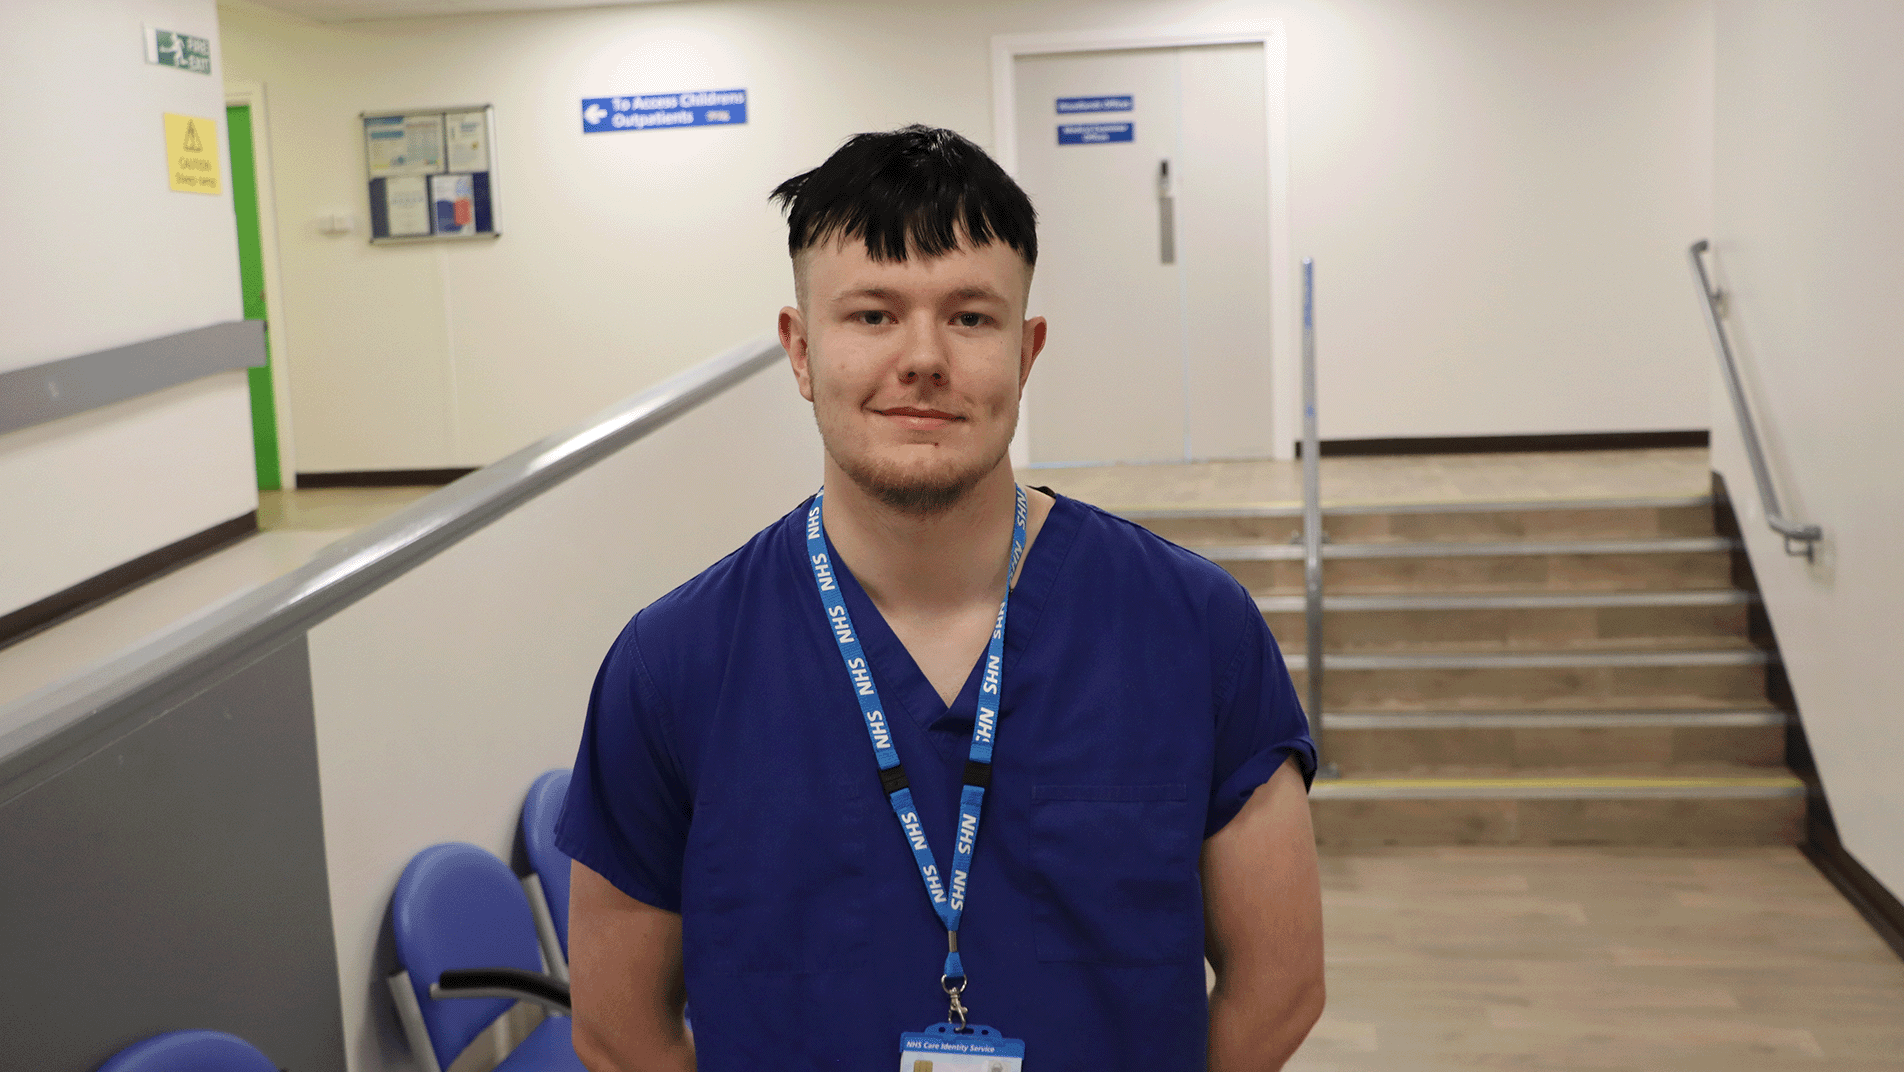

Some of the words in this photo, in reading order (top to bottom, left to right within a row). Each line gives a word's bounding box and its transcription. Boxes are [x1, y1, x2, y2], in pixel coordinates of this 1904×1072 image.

[189, 55, 210, 73] EXIT
[611, 110, 695, 129] Outpatients
[612, 97, 631, 112] To
[632, 95, 679, 111] Access
[808, 506, 820, 540] NHS
[1016, 490, 1028, 531] NHS
[812, 552, 836, 592] NHS
[1010, 540, 1023, 579] NH
[828, 605, 855, 644] NHS
[848, 657, 875, 696] NHS
[983, 655, 1000, 695] NHS
[867, 709, 891, 750] NHS
[901, 811, 928, 851] NHS
[958, 813, 977, 855] NHS
[923, 864, 948, 904] NHS
[951, 869, 967, 911] NHS
[906, 1041, 922, 1050] NHS
[923, 1041, 940, 1050] Care
[940, 1043, 968, 1053] Identity
[970, 1044, 996, 1054] Service
